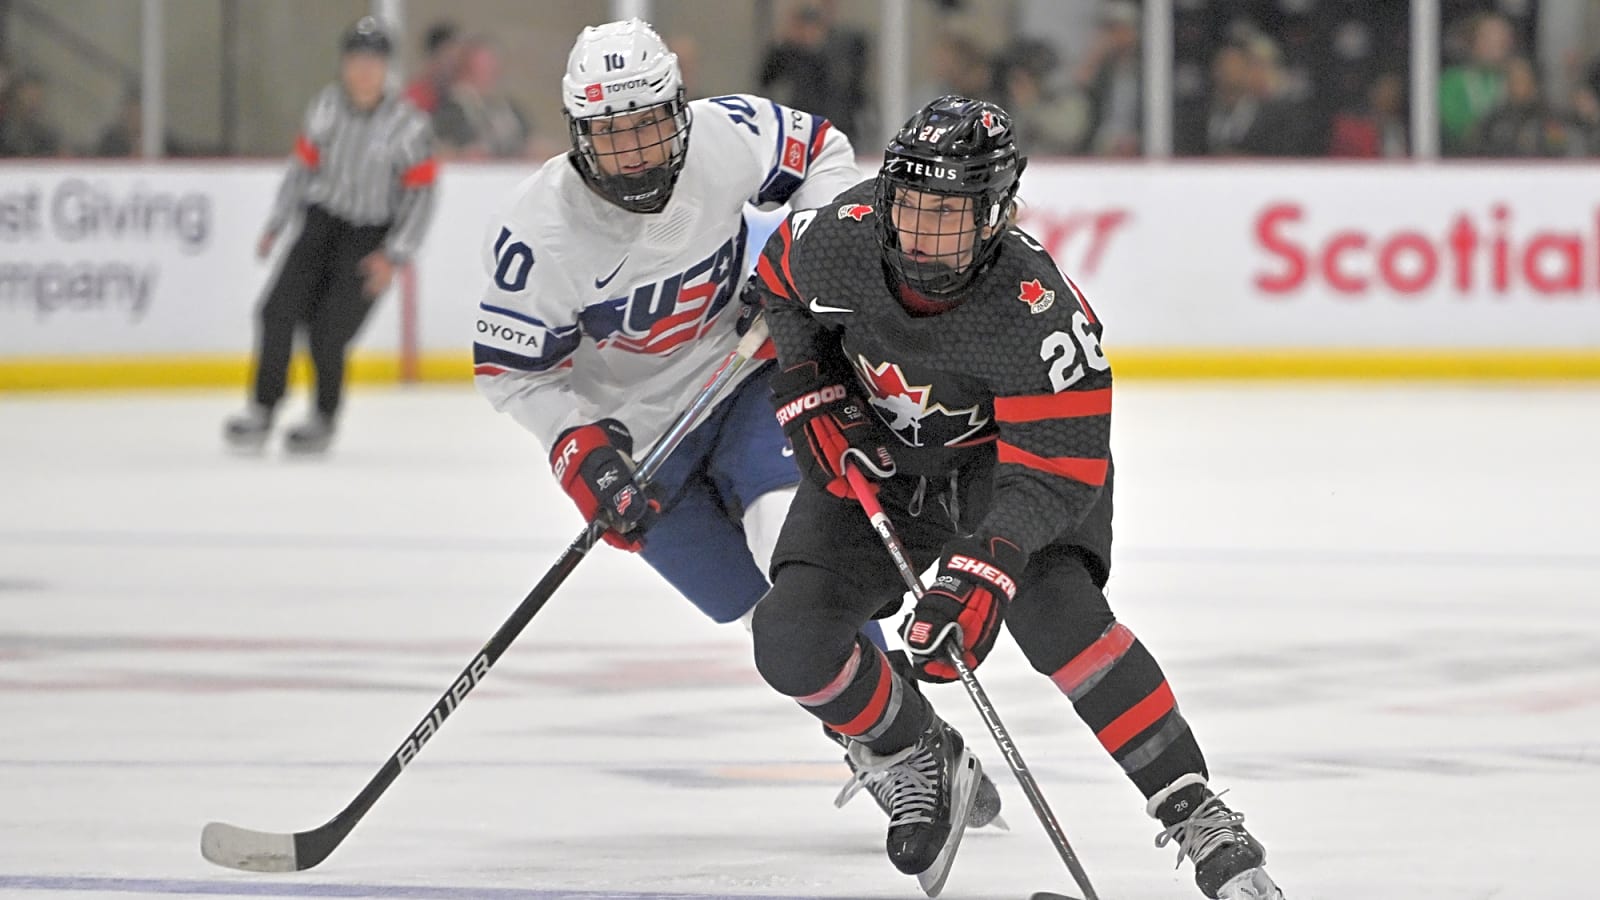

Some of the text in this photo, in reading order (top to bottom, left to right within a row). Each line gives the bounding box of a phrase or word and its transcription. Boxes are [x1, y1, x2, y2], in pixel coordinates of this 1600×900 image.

[603, 52, 625, 72] 10
[605, 78, 648, 93] TOYOTA
[791, 110, 803, 131] TO
[918, 126, 946, 143] 26
[906, 161, 957, 181] TELUS
[52, 179, 210, 255] Giving
[493, 225, 535, 292] 10
[623, 235, 738, 346] USA
[475, 319, 538, 348] OYOTA
[1039, 310, 1111, 394] 26
[775, 384, 847, 428] RWOOD
[553, 438, 579, 481] ER
[1174, 799, 1189, 813] 26
